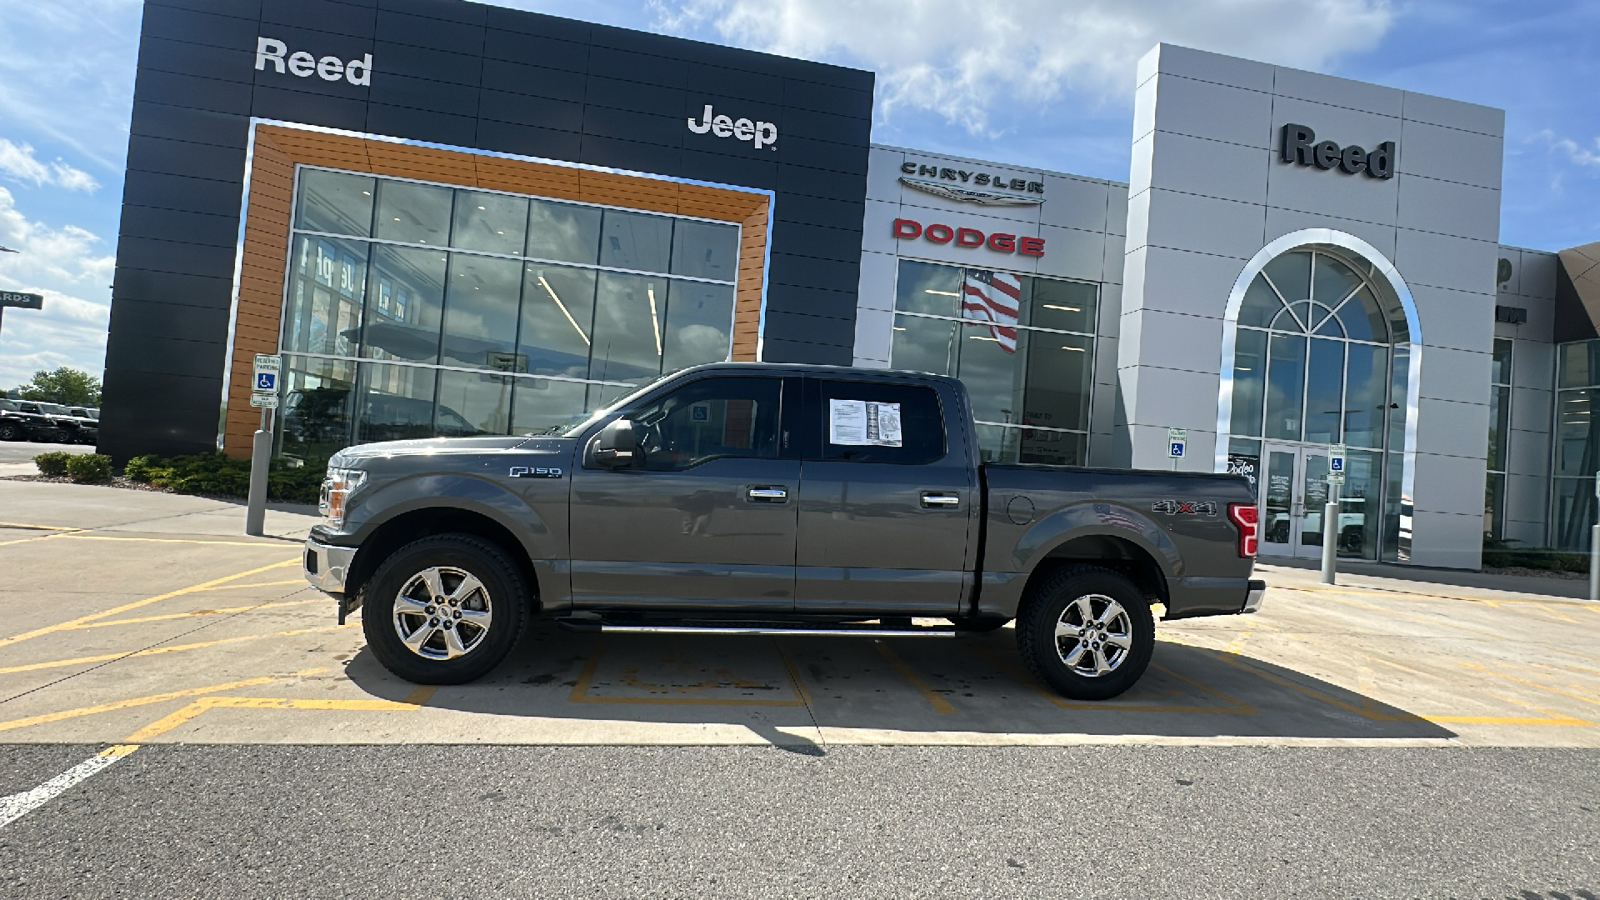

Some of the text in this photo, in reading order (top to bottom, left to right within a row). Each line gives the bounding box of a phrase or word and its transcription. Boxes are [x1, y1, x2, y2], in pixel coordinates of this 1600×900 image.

[254, 36, 373, 87] Reed
[687, 104, 778, 150] Jeep
[1280, 123, 1396, 180] Reed
[902, 162, 1044, 193] CHRYSLER
[893, 218, 1045, 256] DODGE
[0, 292, 31, 303] RDS
